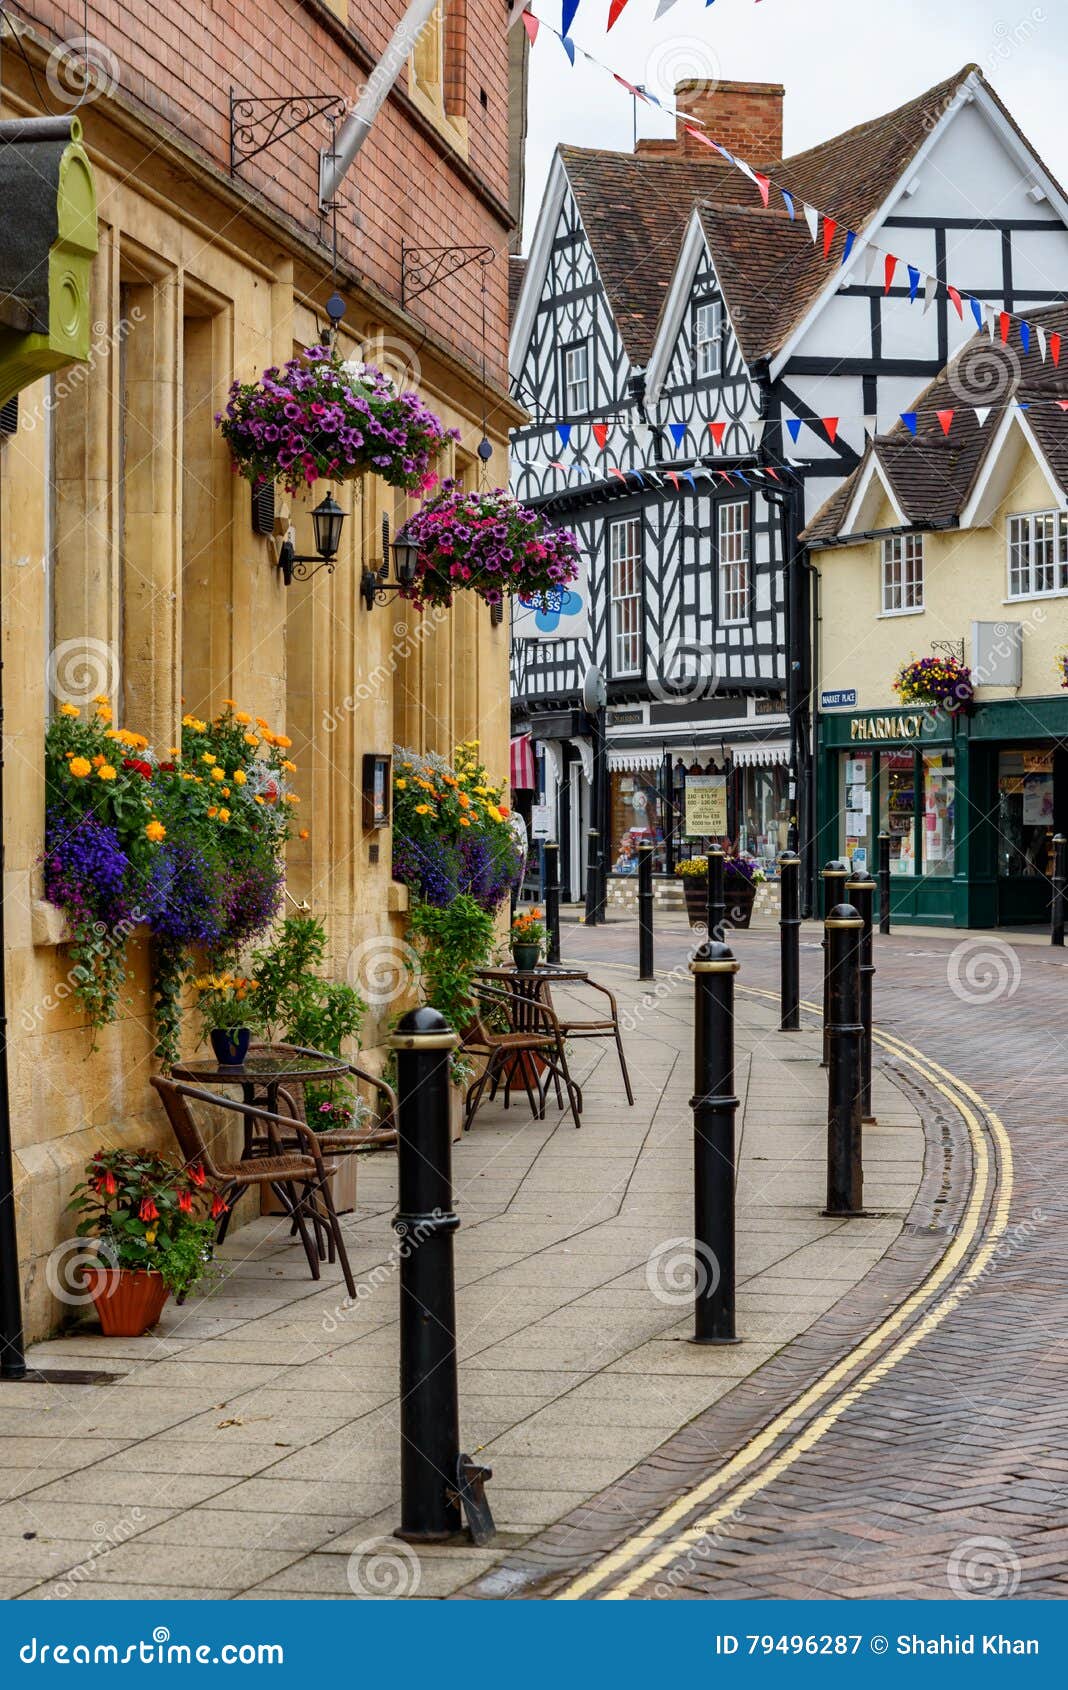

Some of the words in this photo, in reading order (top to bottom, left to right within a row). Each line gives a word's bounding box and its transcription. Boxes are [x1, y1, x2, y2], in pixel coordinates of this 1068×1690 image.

[822, 695, 840, 704] MARKET
[841, 692, 855, 702] PLACE
[851, 715, 924, 740] PHARMACY
